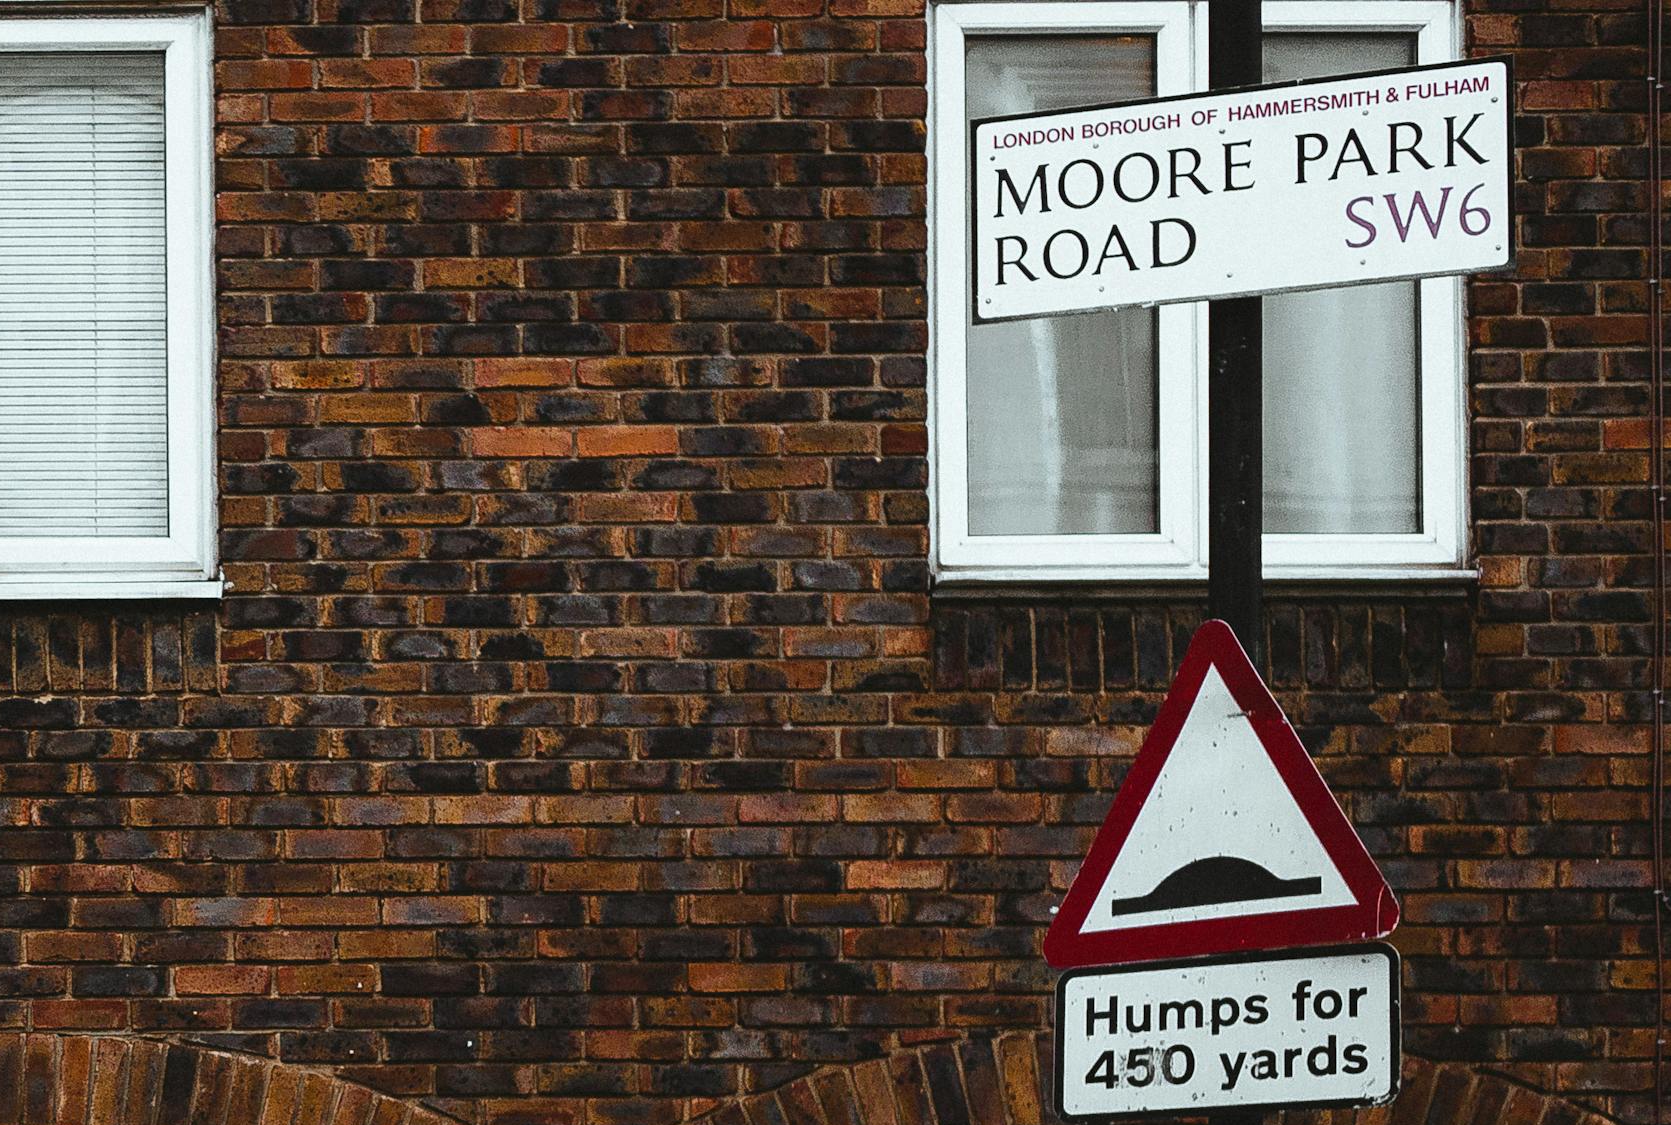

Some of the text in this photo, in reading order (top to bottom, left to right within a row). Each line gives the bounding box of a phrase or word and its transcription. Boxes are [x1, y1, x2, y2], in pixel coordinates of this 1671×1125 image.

[993, 75, 1490, 149] LONDON BOROUGH OF HAMMERSMITH & FULHAM
[993, 112, 1491, 219] MOORE PARK
[994, 183, 1491, 287] ROAD SW6
[1085, 979, 1368, 1037] Humps for
[1084, 1034, 1369, 1092] 450 yards
